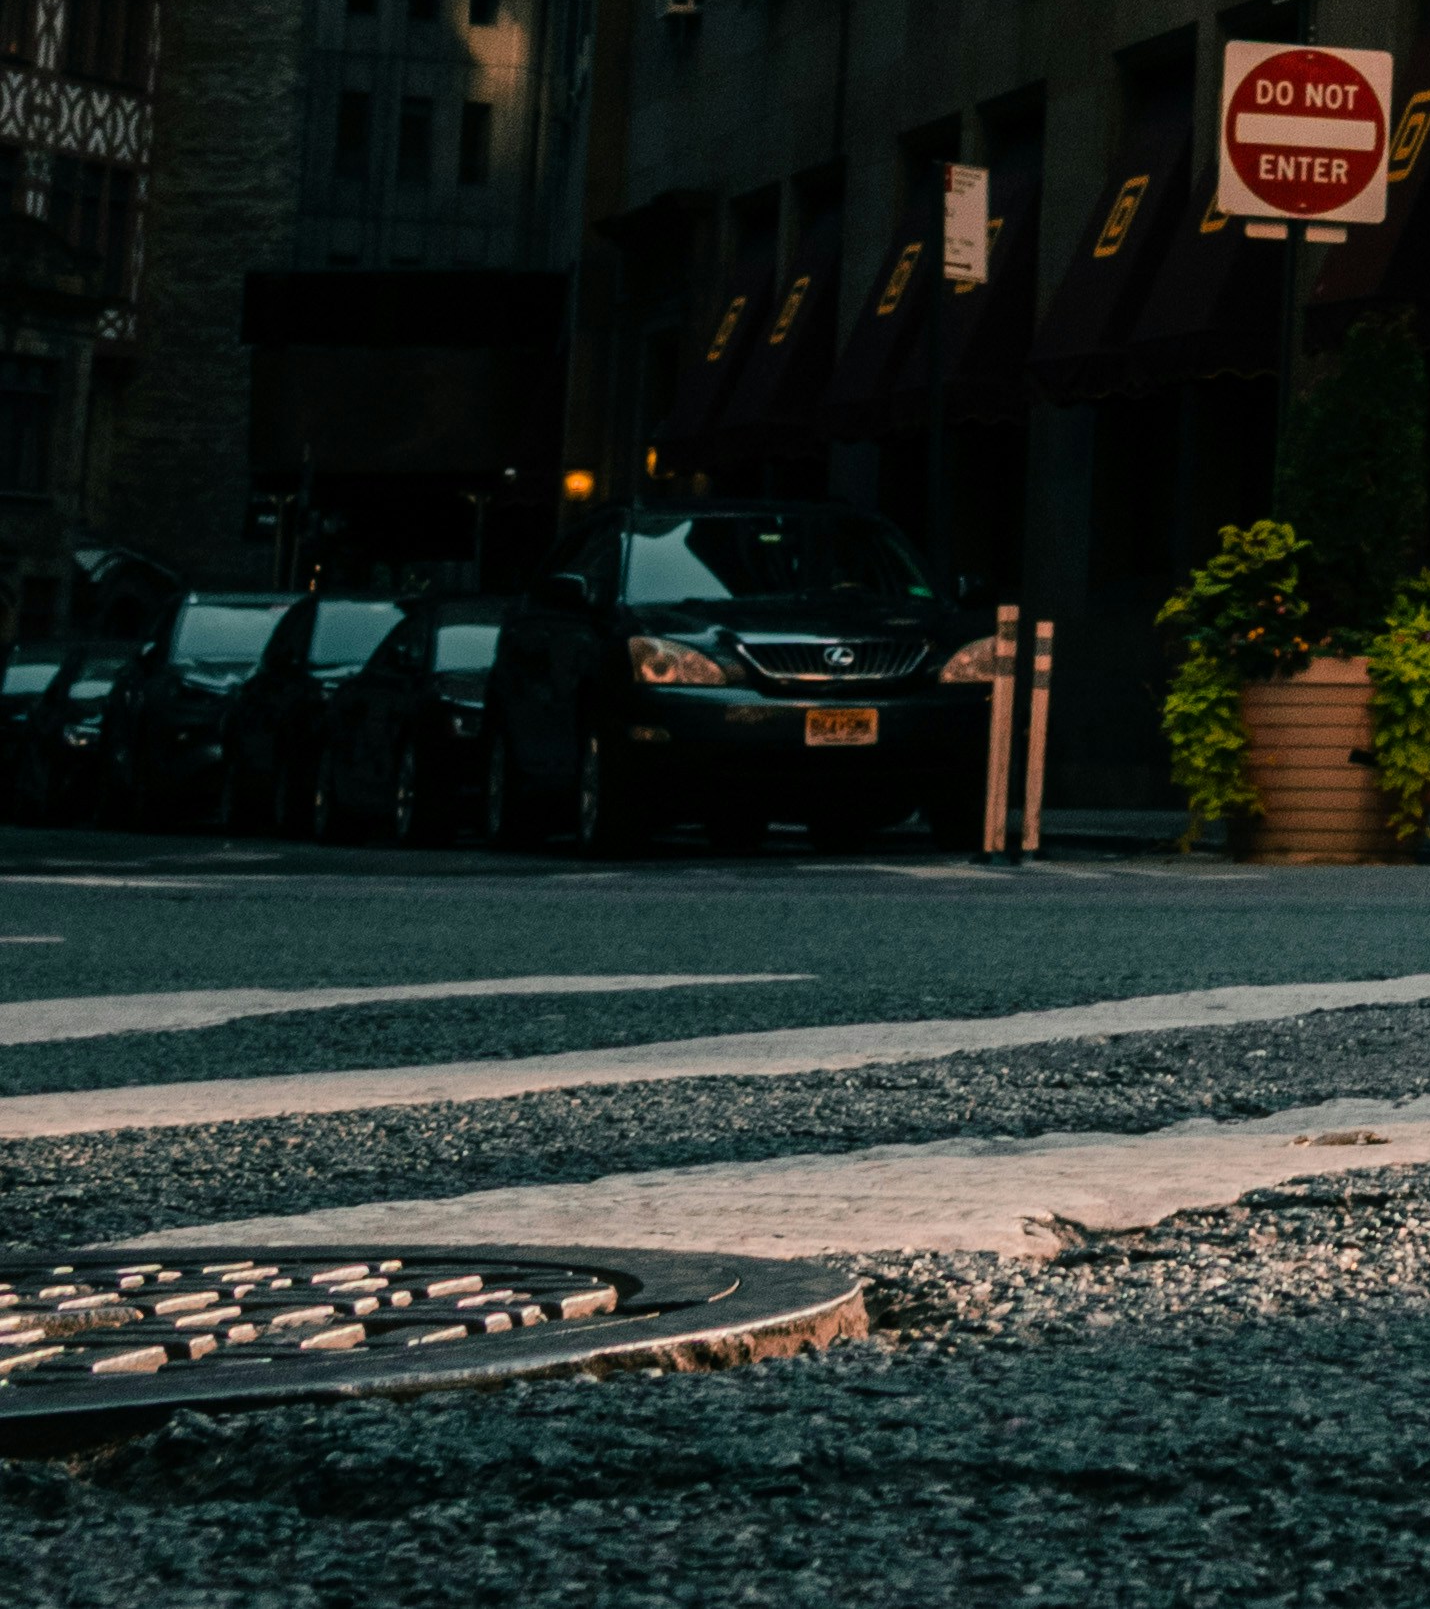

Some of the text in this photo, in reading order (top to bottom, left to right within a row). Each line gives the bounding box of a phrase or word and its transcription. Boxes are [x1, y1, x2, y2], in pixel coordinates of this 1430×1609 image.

[1256, 79, 1359, 110] DO NOT
[1260, 154, 1349, 184] ENTER
